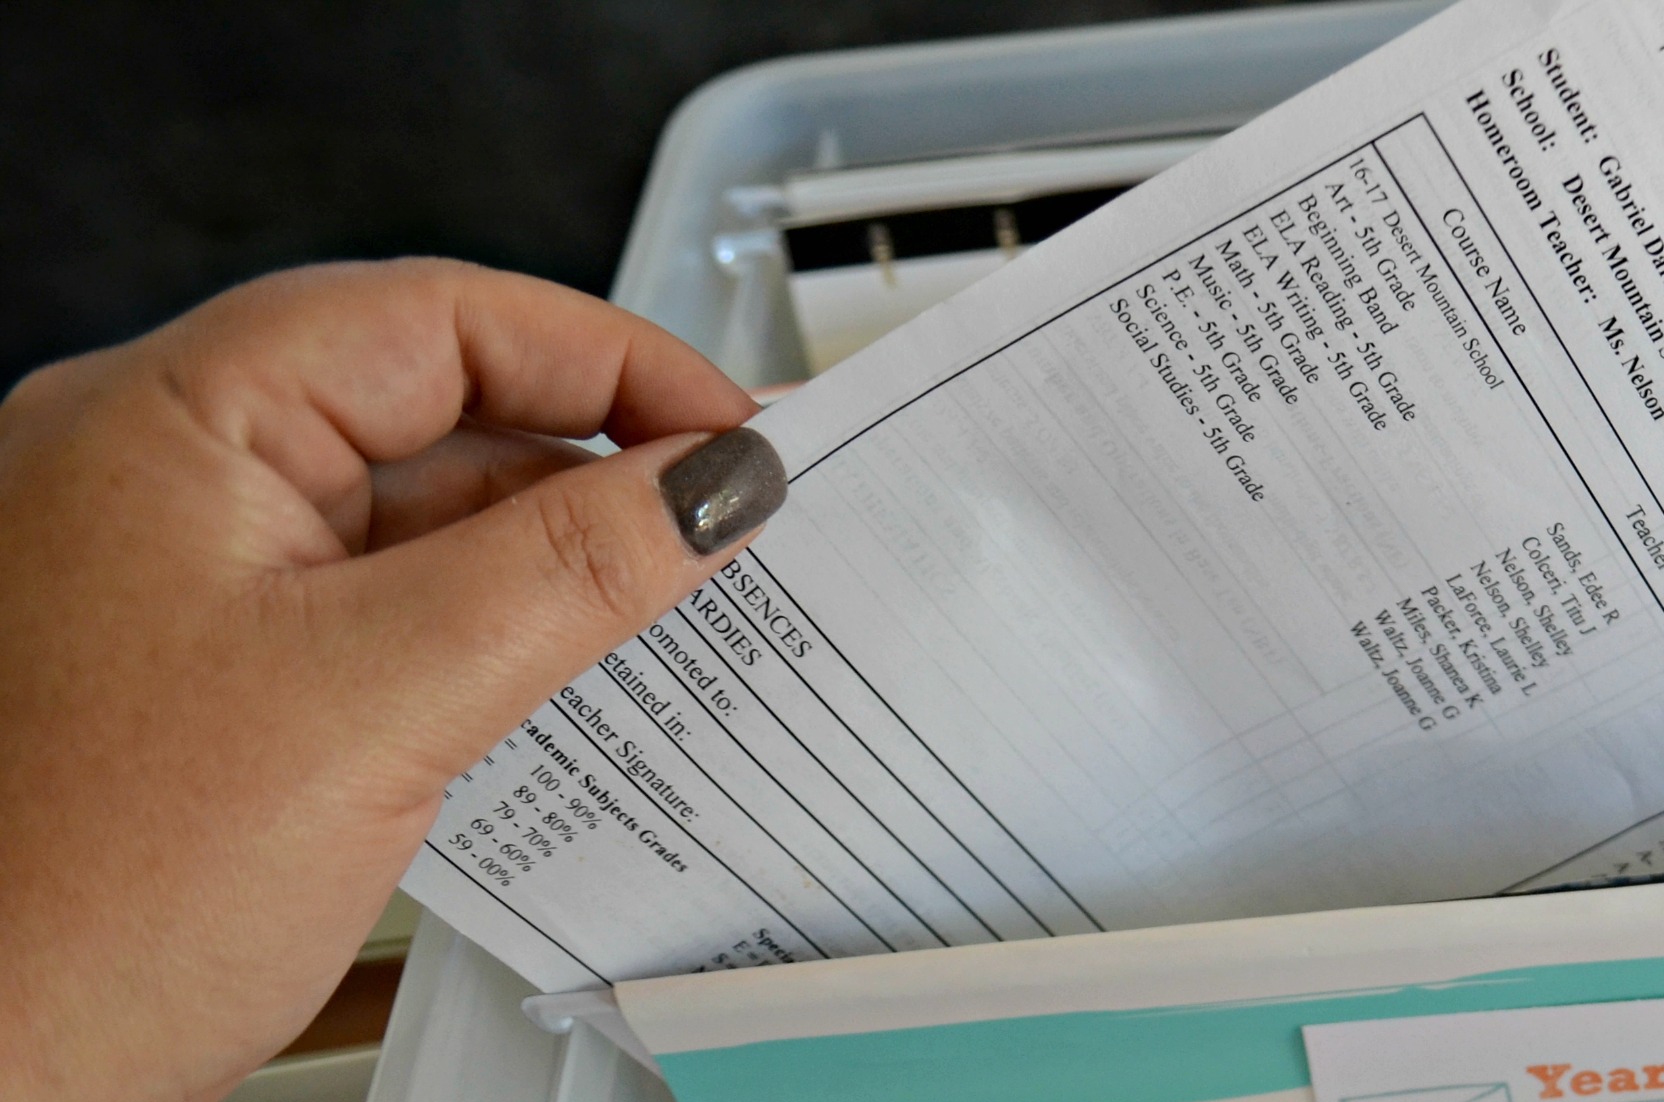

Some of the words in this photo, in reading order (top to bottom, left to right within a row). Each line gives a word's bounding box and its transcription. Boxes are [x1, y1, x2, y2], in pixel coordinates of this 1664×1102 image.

[1538, 48, 1598, 144] Student:
[1598, 155, 1655, 237] Gabriel
[1297, 193, 1363, 289] Beginning
[1357, 285, 1400, 335] Band
[1324, 183, 1354, 213] Art
[1354, 226, 1383, 258] 5th
[1376, 258, 1416, 312] Grade
[1465, 89, 1542, 212] Homeroom
[1539, 210, 1597, 304] Teacher:
[1598, 315, 1625, 356] Ms.
[1501, 68, 1556, 152] School:
[1562, 173, 1611, 244] Desert
[1601, 243, 1664, 344] Mountain
[1188, 253, 1233, 311] Music
[1235, 323, 1264, 354] 5th
[1258, 354, 1298, 405] Grade
[1215, 238, 1256, 289] Math
[1256, 301, 1285, 332] 5th
[1280, 332, 1319, 384] Grade
[1242, 224, 1280, 271] ELA
[1276, 269, 1325, 341] Writing
[1327, 351, 1354, 381] 5th
[1348, 381, 1387, 431] Grade
[1269, 209, 1307, 257] ELA
[1300, 254, 1354, 331] Reading
[1356, 341, 1384, 372] 5th
[1377, 371, 1416, 422] Grade
[1349, 157, 1389, 203] 16-17
[1382, 209, 1423, 265] Desert
[1415, 262, 1468, 339] Mountain
[1462, 337, 1505, 390] School
[1442, 208, 1490, 278] Course
[1484, 275, 1526, 336] Name
[1135, 283, 1188, 351] Science
[1192, 364, 1221, 393] 5th
[1215, 393, 1255, 443] Grade
[1161, 268, 1195, 308] P.E.
[1197, 321, 1226, 351] 5th
[1221, 351, 1261, 403] Grade
[1109, 298, 1159, 354] Social
[1149, 352, 1200, 416] Studies
[1202, 427, 1231, 455] 5th
[1225, 454, 1264, 502] Grade
[720, 558, 813, 658] BSENCES
[1469, 559, 1511, 619] Nelson,
[1508, 616, 1550, 668] Shelley
[1494, 546, 1536, 607] Nelson,
[1532, 604, 1573, 657] Shelley
[1521, 536, 1567, 596] Colceri,
[1546, 522, 1582, 574] Sands,
[1577, 570, 1608, 610] Edee
[1601, 608, 1620, 626] R
[649, 624, 719, 691] omoted
[710, 689, 738, 717] to:
[690, 588, 763, 666] ARDIES
[1349, 619, 1385, 670] Waltz,
[1381, 668, 1422, 716] Joanne
[1418, 716, 1437, 731] G
[1374, 608, 1409, 659] Waltz,
[1405, 657, 1446, 705] Joanne
[1441, 705, 1461, 720] G
[1395, 596, 1432, 645] Miles,
[1428, 643, 1470, 695] Shanea
[1463, 692, 1484, 710] K
[1420, 585, 1462, 641] Packer,
[1458, 638, 1502, 695] Kristina
[1444, 572, 1492, 639] LaForce,
[1489, 636, 1527, 683] Laurie
[1520, 681, 1537, 697] L
[560, 686, 619, 742] eacher
[615, 740, 699, 823] Signature:
[604, 652, 672, 717] etained
[663, 711, 691, 742] in:
[470, 818, 495, 836] 69
[499, 843, 536, 873] 60%
[492, 800, 516, 820] 79
[521, 826, 558, 858] 70%
[512, 785, 537, 804] 89
[541, 811, 578, 843] 80%
[520, 719, 580, 777] cademic
[577, 774, 639, 832] Subjects
[638, 829, 688, 873] Grades
[530, 764, 561, 792] 100
[564, 798, 602, 830] 90%
[447, 833, 474, 851] 59
[478, 857, 516, 887] 00%
